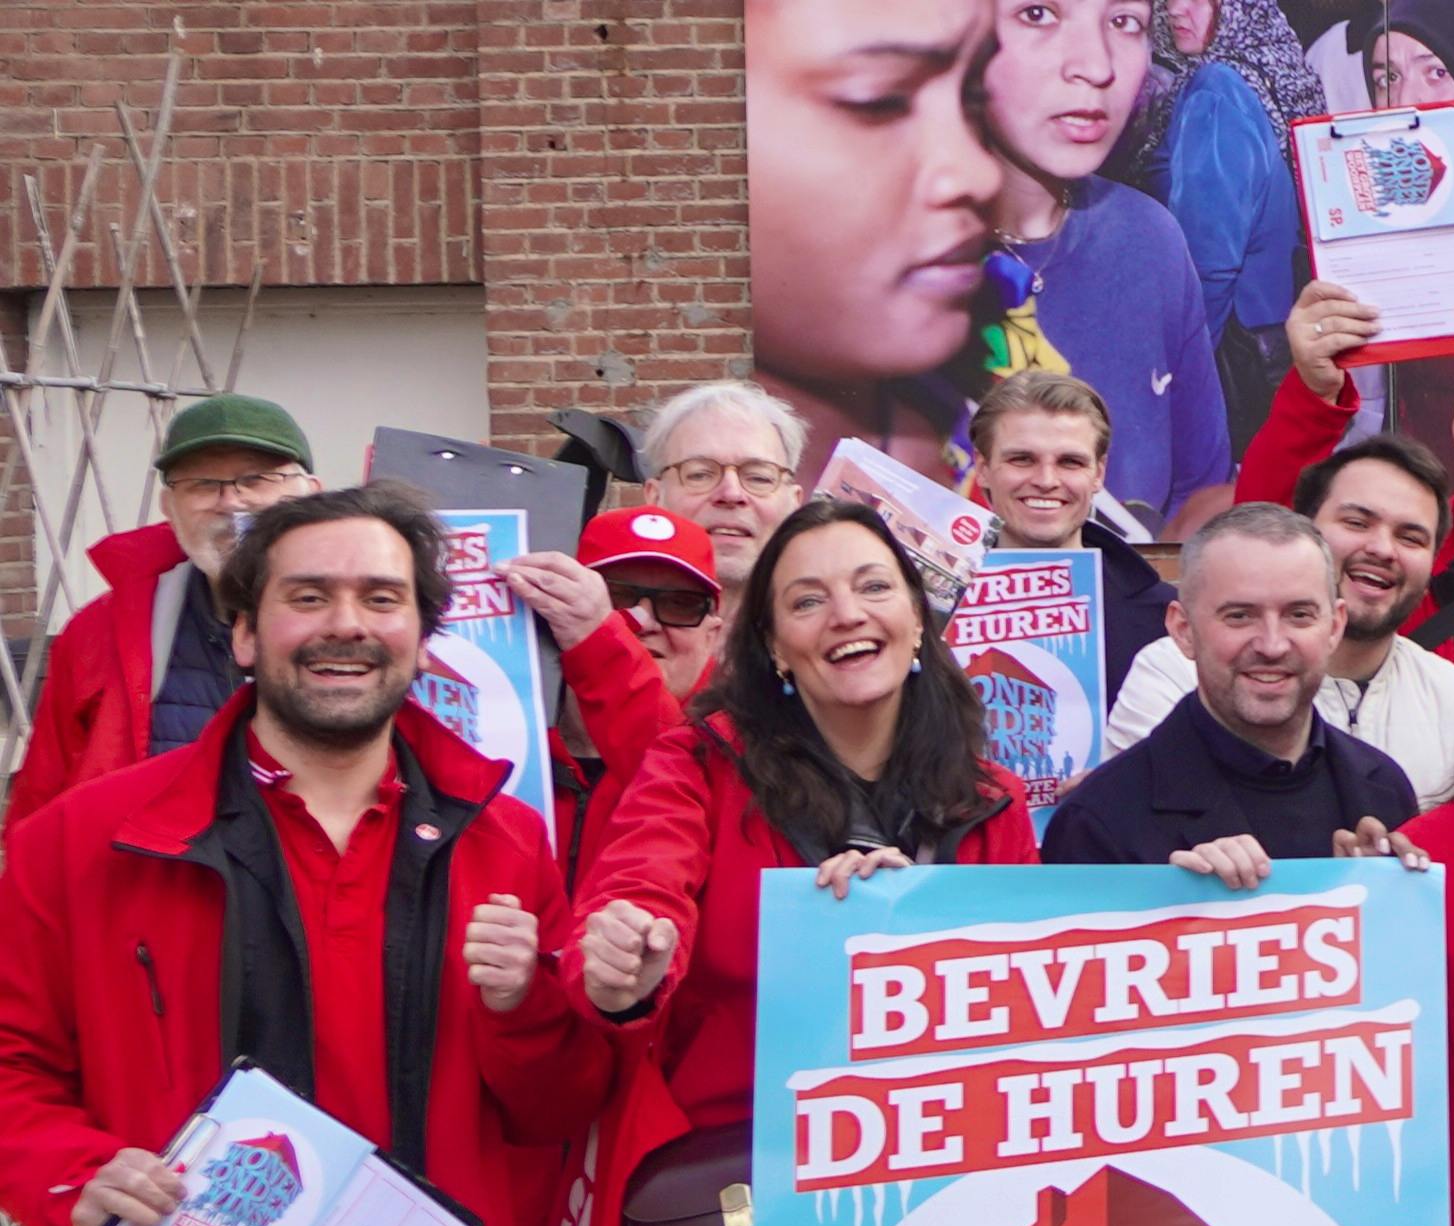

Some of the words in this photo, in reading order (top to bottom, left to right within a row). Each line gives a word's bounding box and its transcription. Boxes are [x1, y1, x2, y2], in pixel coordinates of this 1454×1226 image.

[963, 567, 1072, 605] VRIES
[955, 604, 1089, 643] HUREN
[971, 672, 1057, 715] ONEN
[852, 916, 1360, 1051] BEVRIES
[796, 1083, 964, 1181] DE
[997, 1028, 1412, 1158] HUREN
